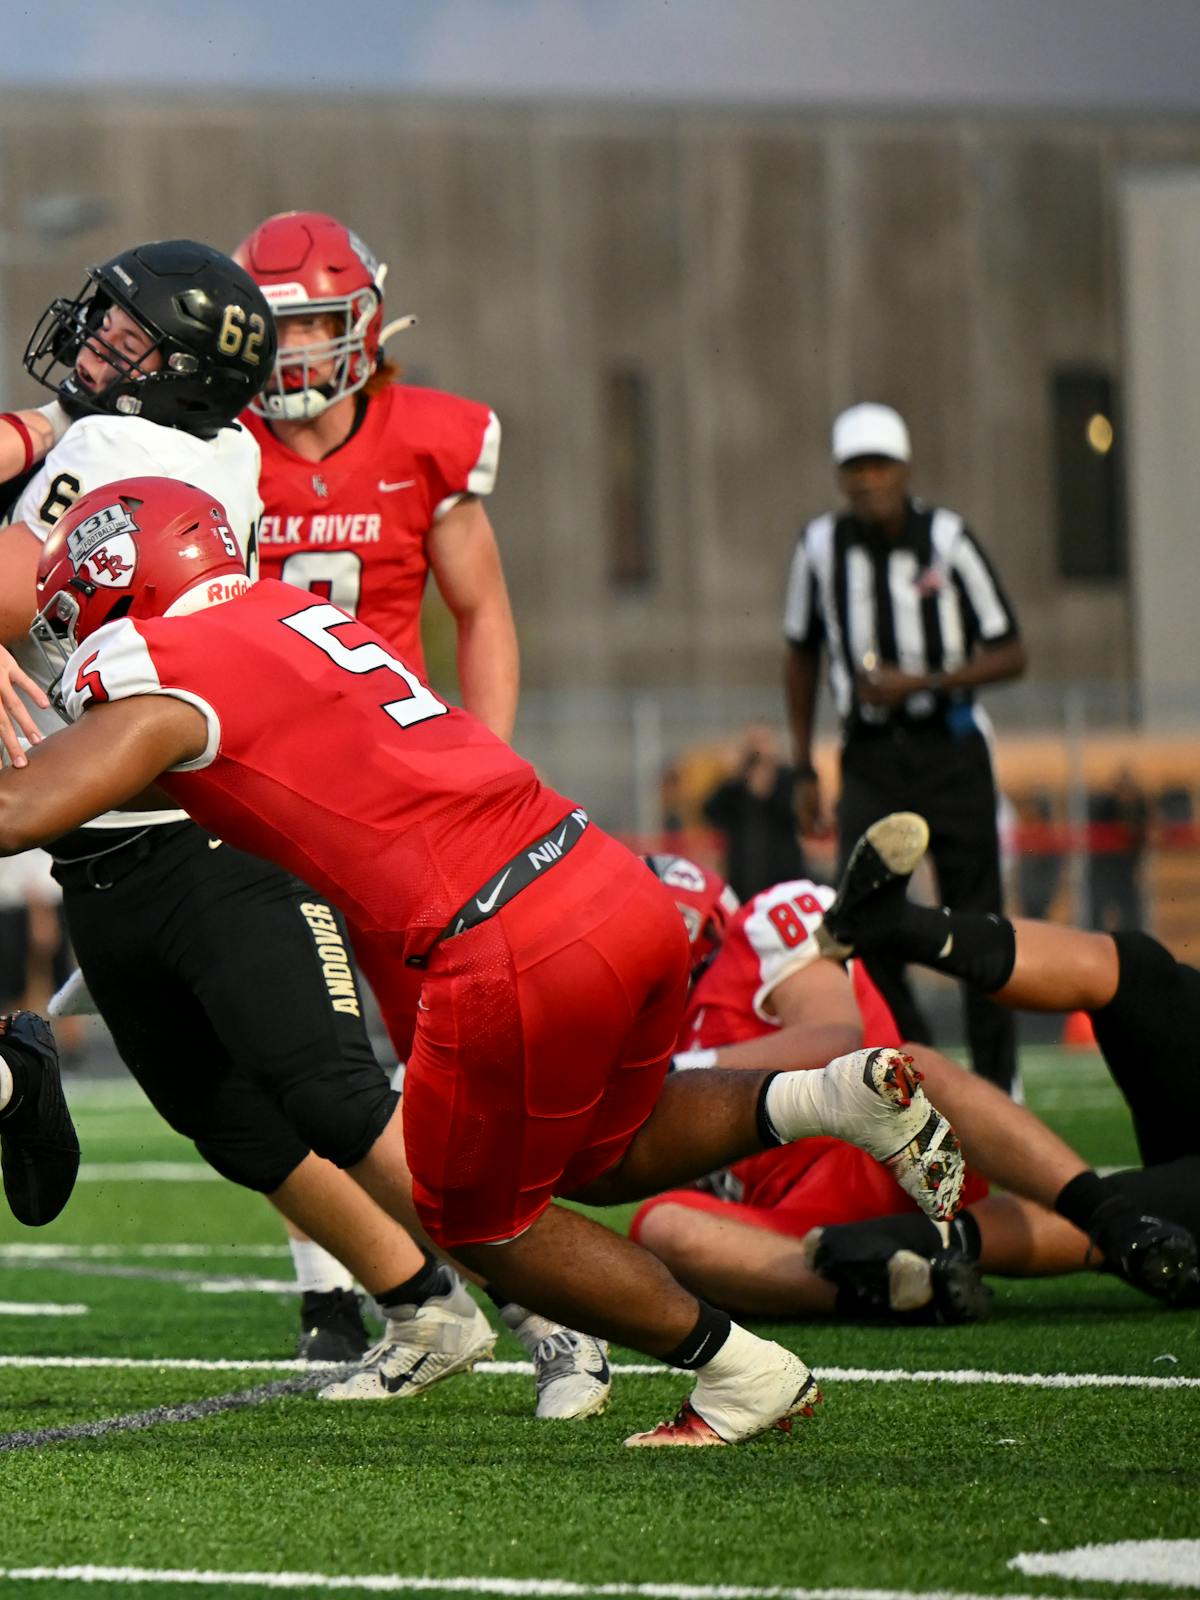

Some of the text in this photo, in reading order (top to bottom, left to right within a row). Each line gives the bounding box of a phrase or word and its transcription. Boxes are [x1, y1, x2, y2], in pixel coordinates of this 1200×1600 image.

[218, 304, 266, 366] 62
[72, 509, 117, 546] 131
[83, 524, 116, 550] FOOTBALL
[217, 525, 238, 558] 5
[258, 513, 382, 544] ELK RIVER
[88, 546, 134, 582] ER
[74, 648, 110, 712] 5
[277, 602, 450, 731] 5
[300, 902, 361, 1018] ANDOVER
